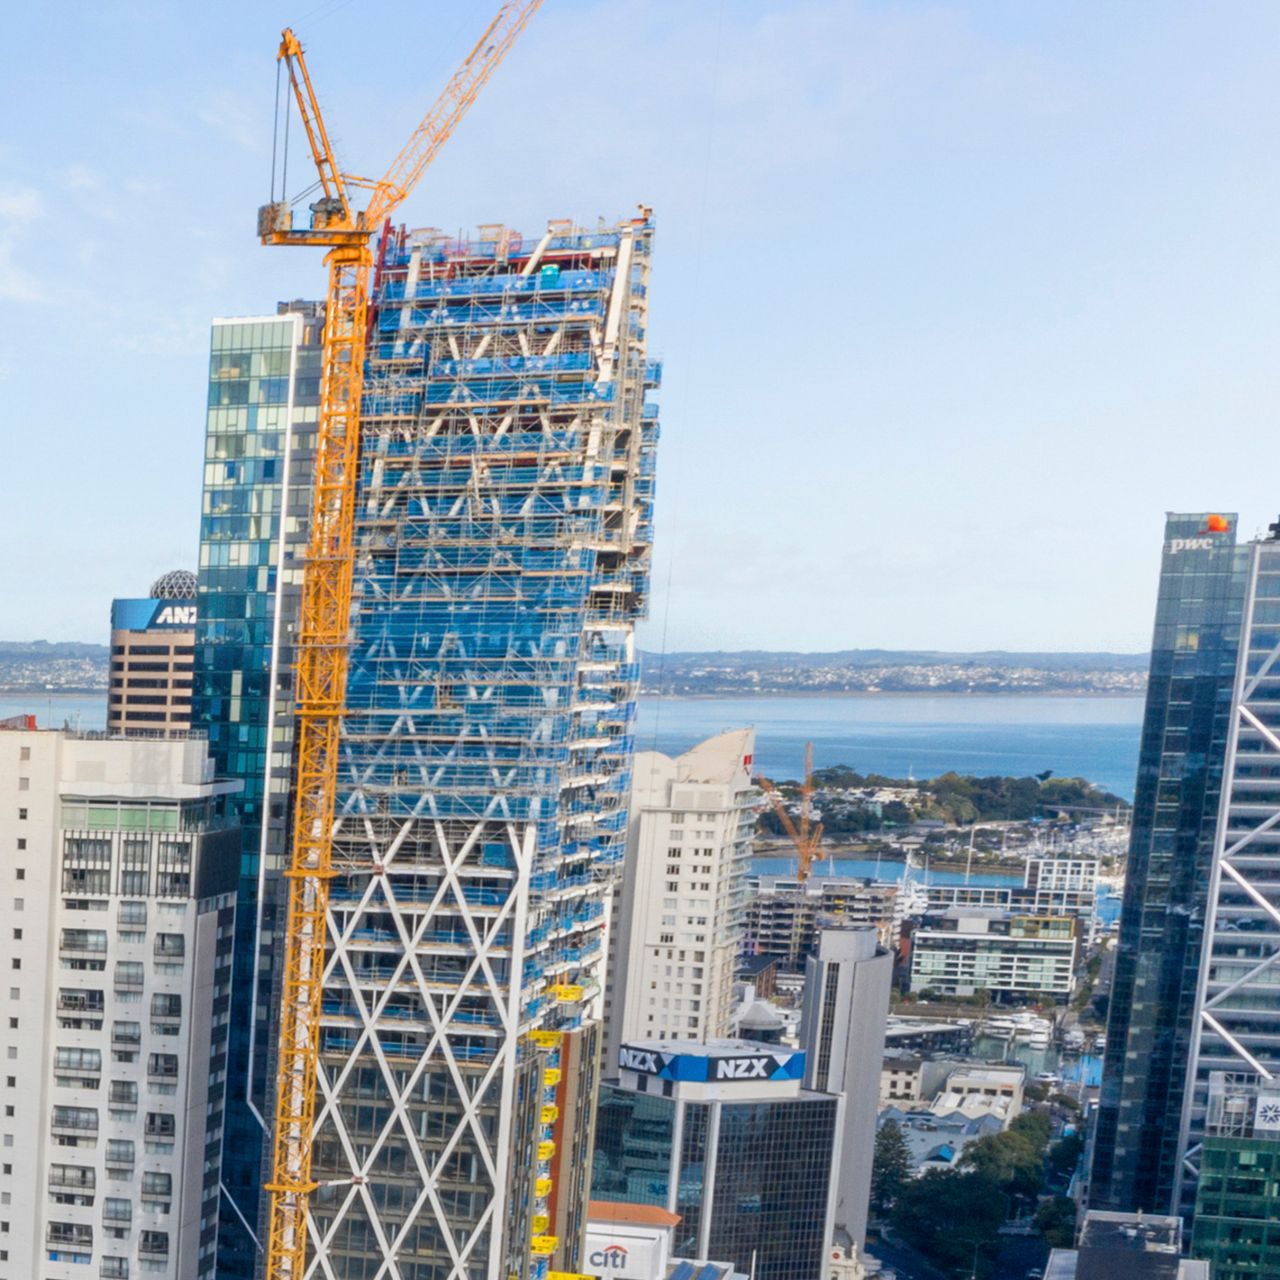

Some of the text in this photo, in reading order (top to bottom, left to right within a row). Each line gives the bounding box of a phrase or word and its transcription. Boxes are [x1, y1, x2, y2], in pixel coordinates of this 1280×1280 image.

[1169, 538, 1213, 554] pwc
[620, 1049, 657, 1072] NZX
[717, 1058, 768, 1078] NZX
[590, 1246, 627, 1268] citi
